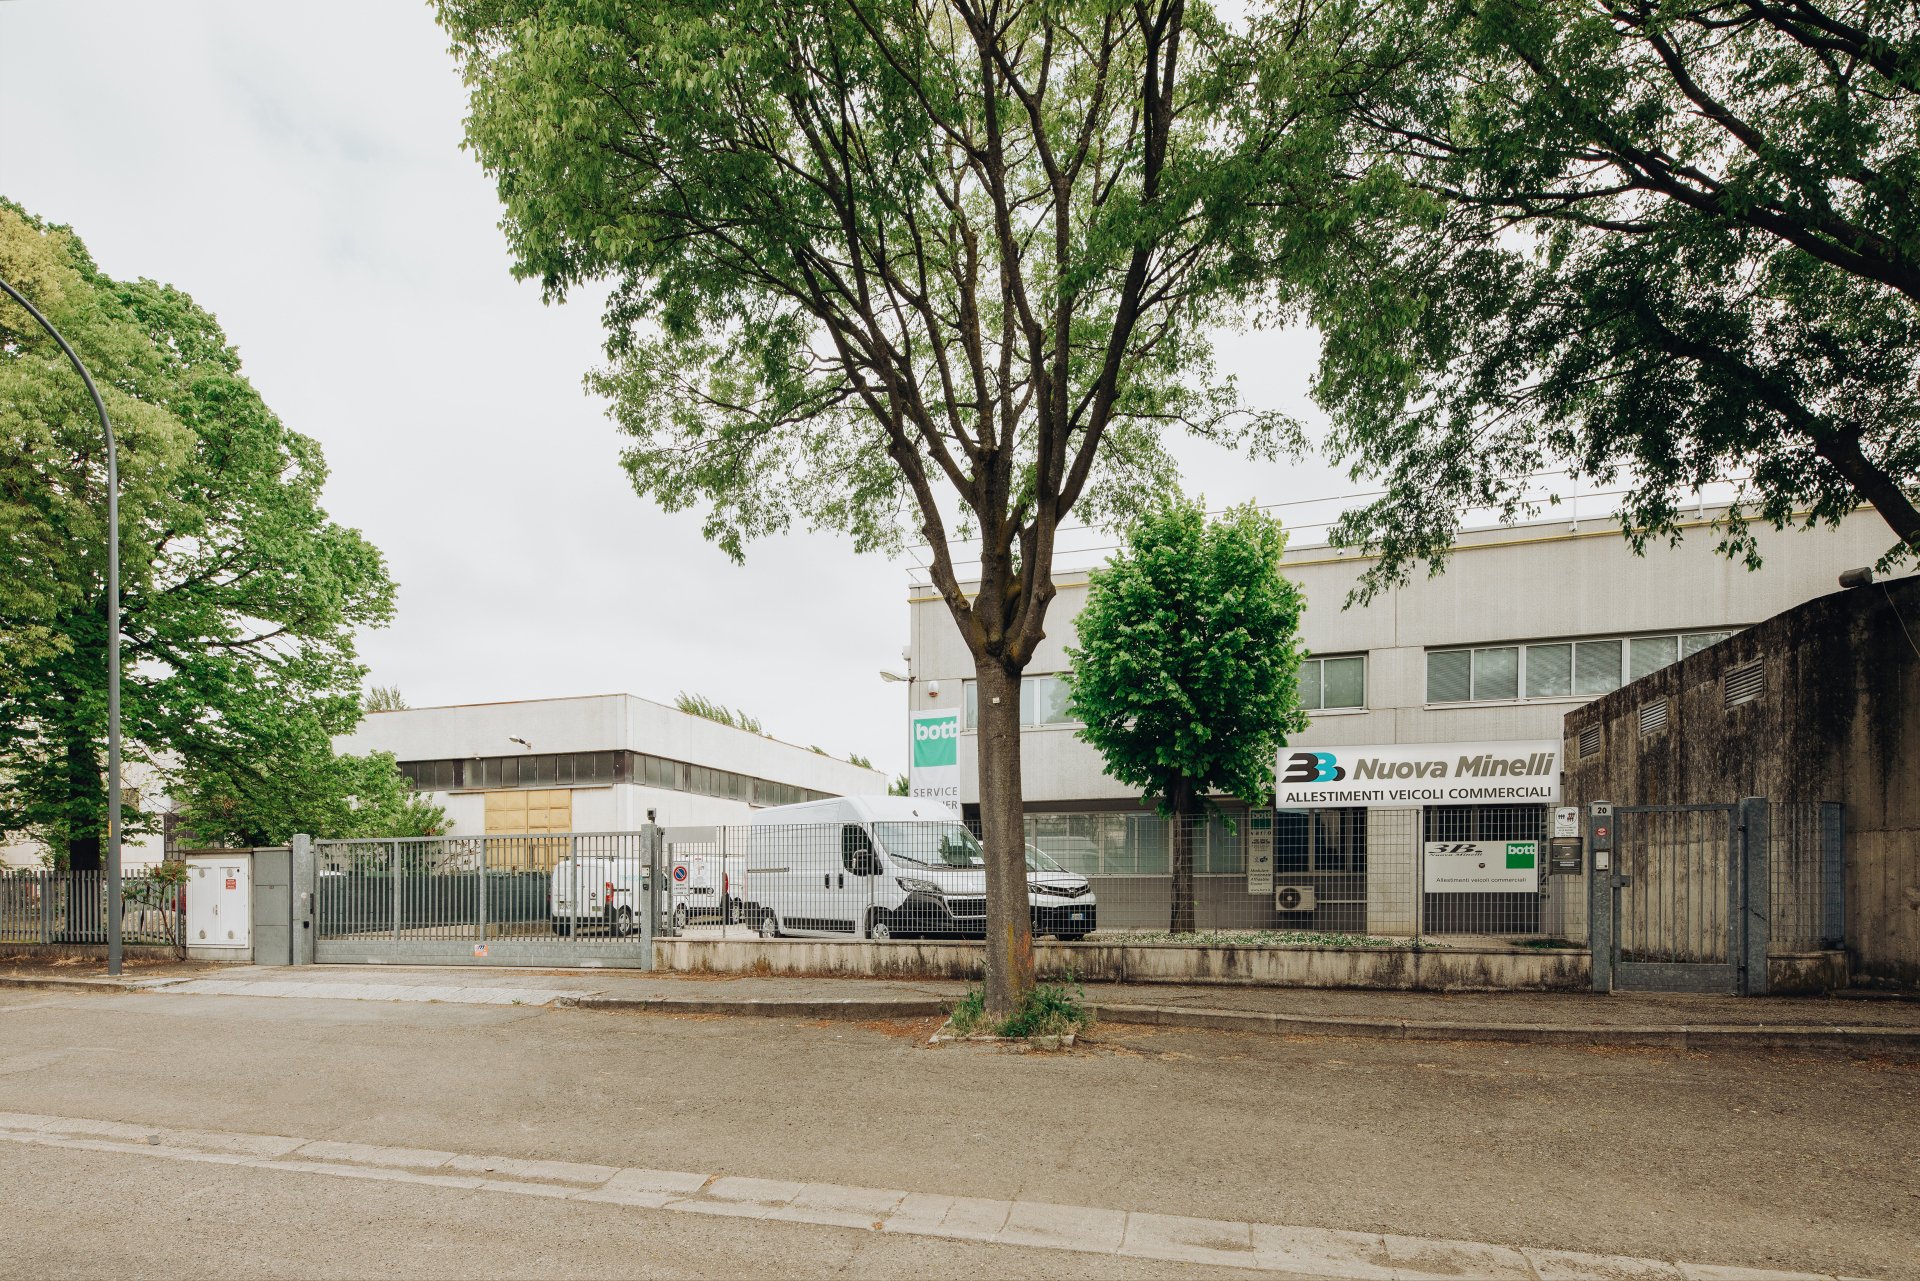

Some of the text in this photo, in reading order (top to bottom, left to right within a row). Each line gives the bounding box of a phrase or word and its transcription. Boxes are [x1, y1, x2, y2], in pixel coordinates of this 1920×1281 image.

[916, 720, 957, 741] bott
[1353, 758, 1448, 780] Nuova
[1454, 752, 1556, 778] Minelli
[913, 786, 958, 798] SERVICE
[1285, 786, 1552, 803] ALLESTIMENTI VEICOLI COMMERCIALI
[1597, 806, 1607, 814] 20
[1507, 845, 1535, 855] bott
